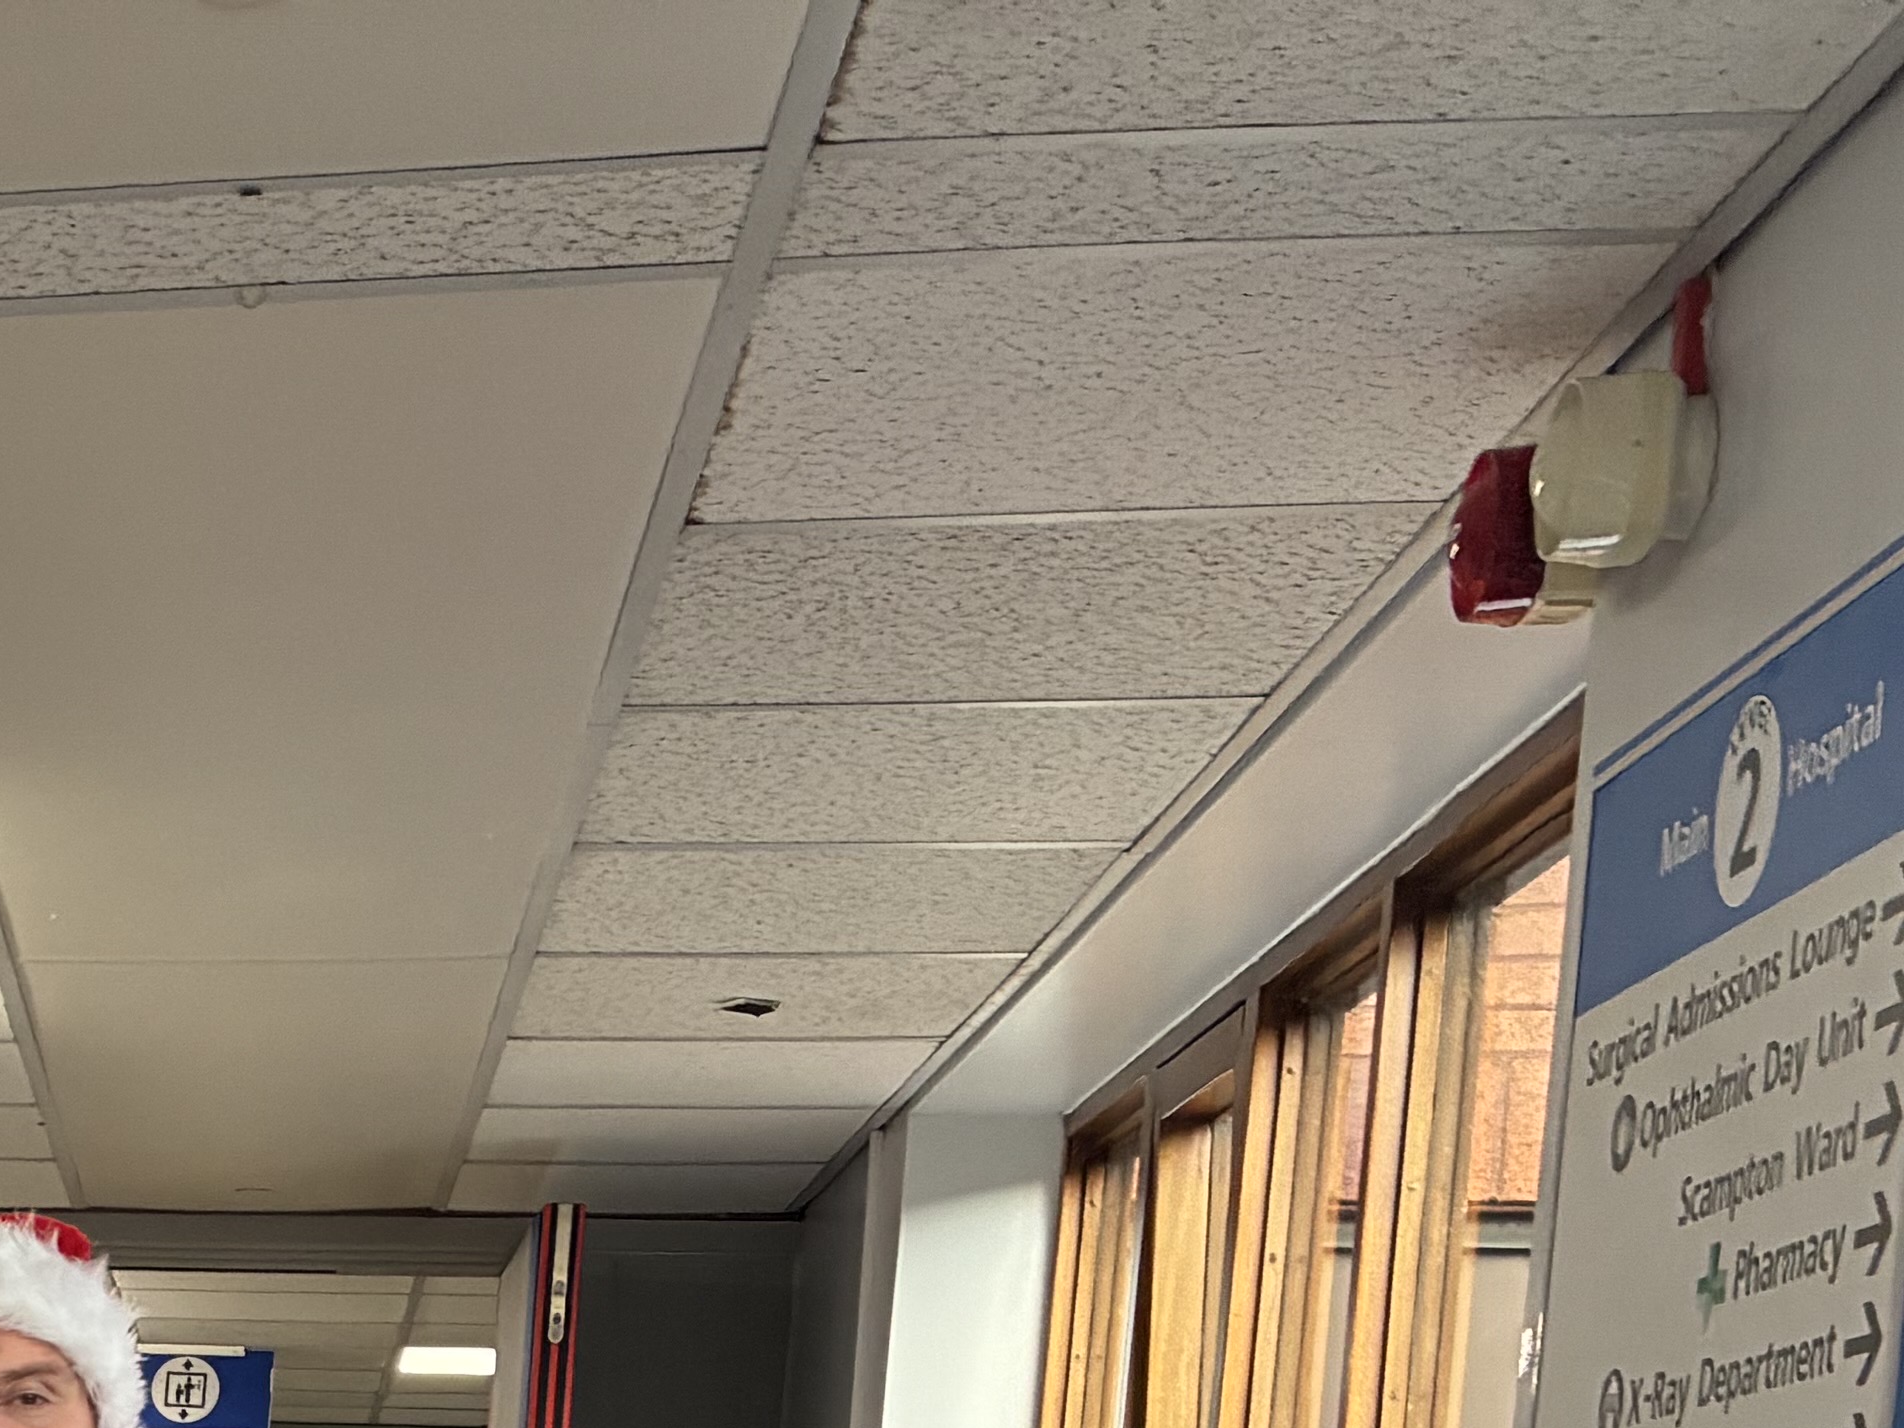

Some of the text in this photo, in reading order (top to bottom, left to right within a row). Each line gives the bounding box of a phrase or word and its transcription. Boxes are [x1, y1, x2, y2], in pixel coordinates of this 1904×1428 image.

[1729, 747, 1761, 878] 2
[1586, 899, 1877, 1086] Surgical Admissions Lounge
[1639, 997, 1866, 1159] Ophthalmic Day Unit
[1677, 1100, 1860, 1227] Scampton Ward
[1733, 1224, 1847, 1301] Pharmacy
[1626, 1324, 1837, 1428] X-Ray Department
